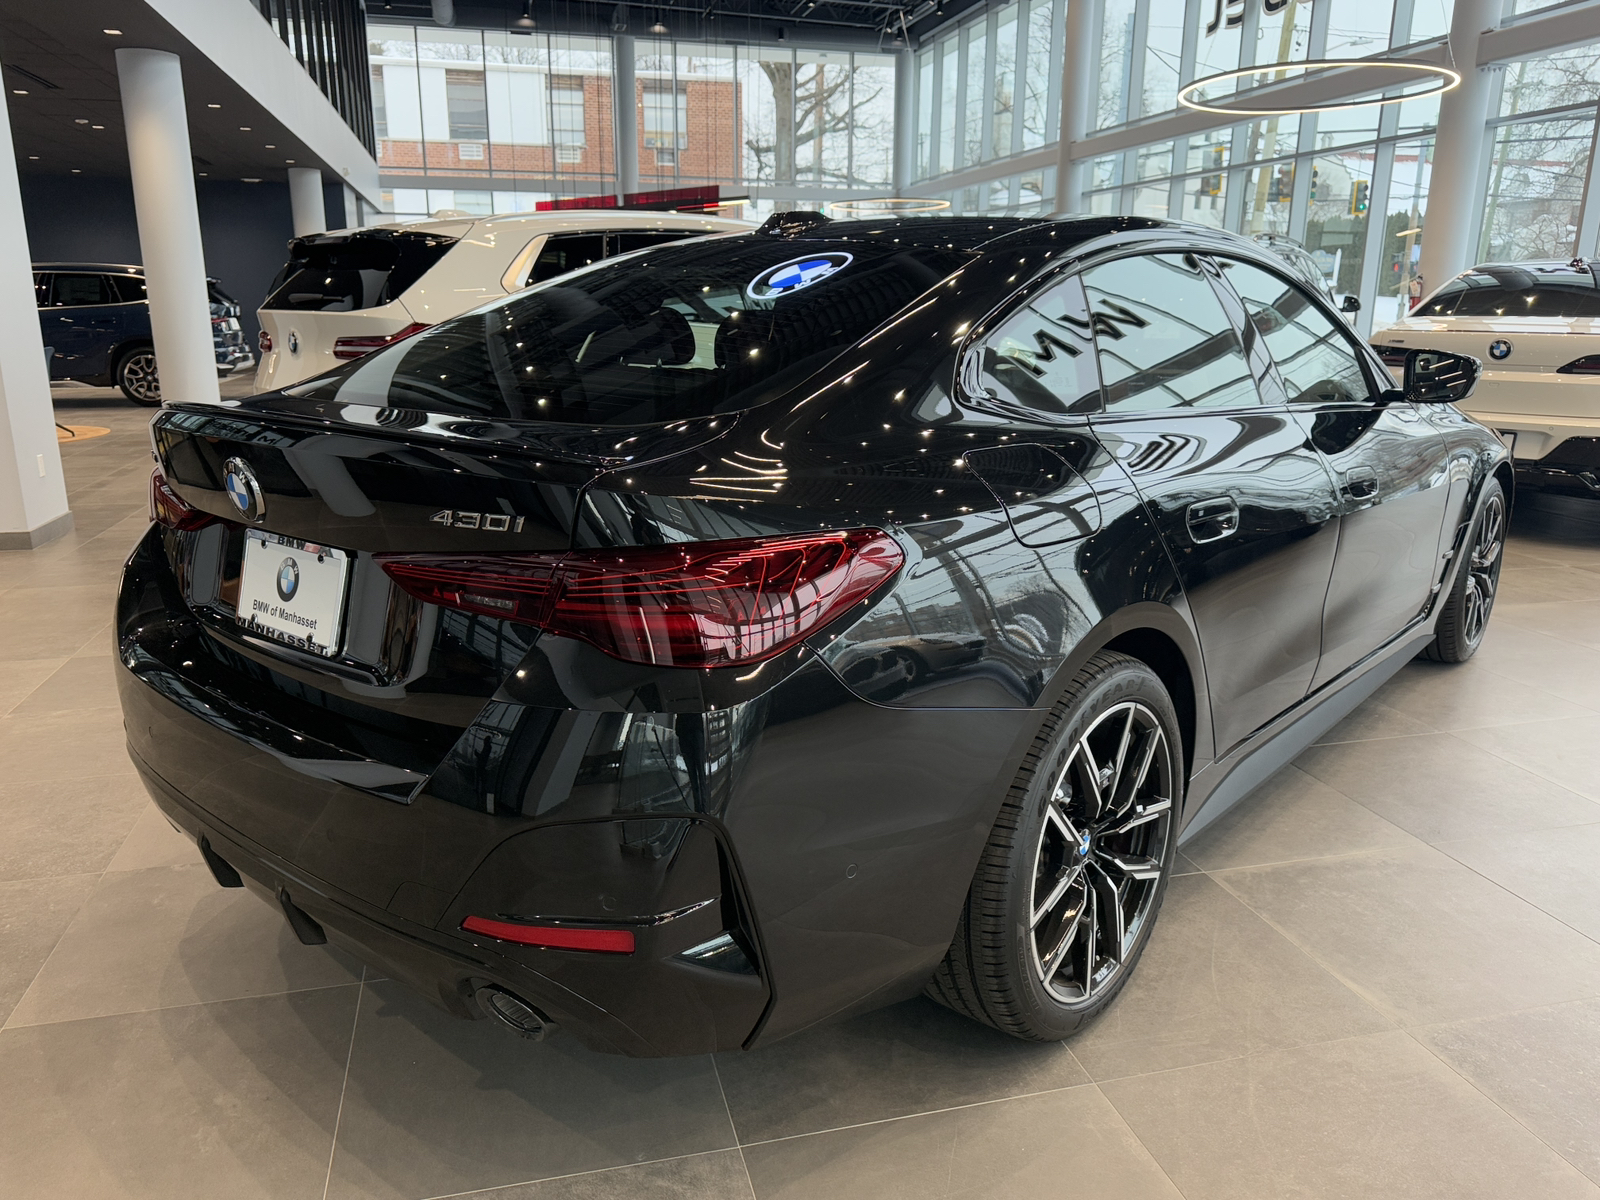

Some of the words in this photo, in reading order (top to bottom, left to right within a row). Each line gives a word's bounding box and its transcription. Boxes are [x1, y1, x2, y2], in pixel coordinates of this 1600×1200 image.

[278, 536, 305, 551] BMW
[252, 599, 271, 615] BMW
[270, 606, 279, 618] of
[278, 607, 318, 631] Manhasset
[237, 617, 329, 657] MANHASSET
